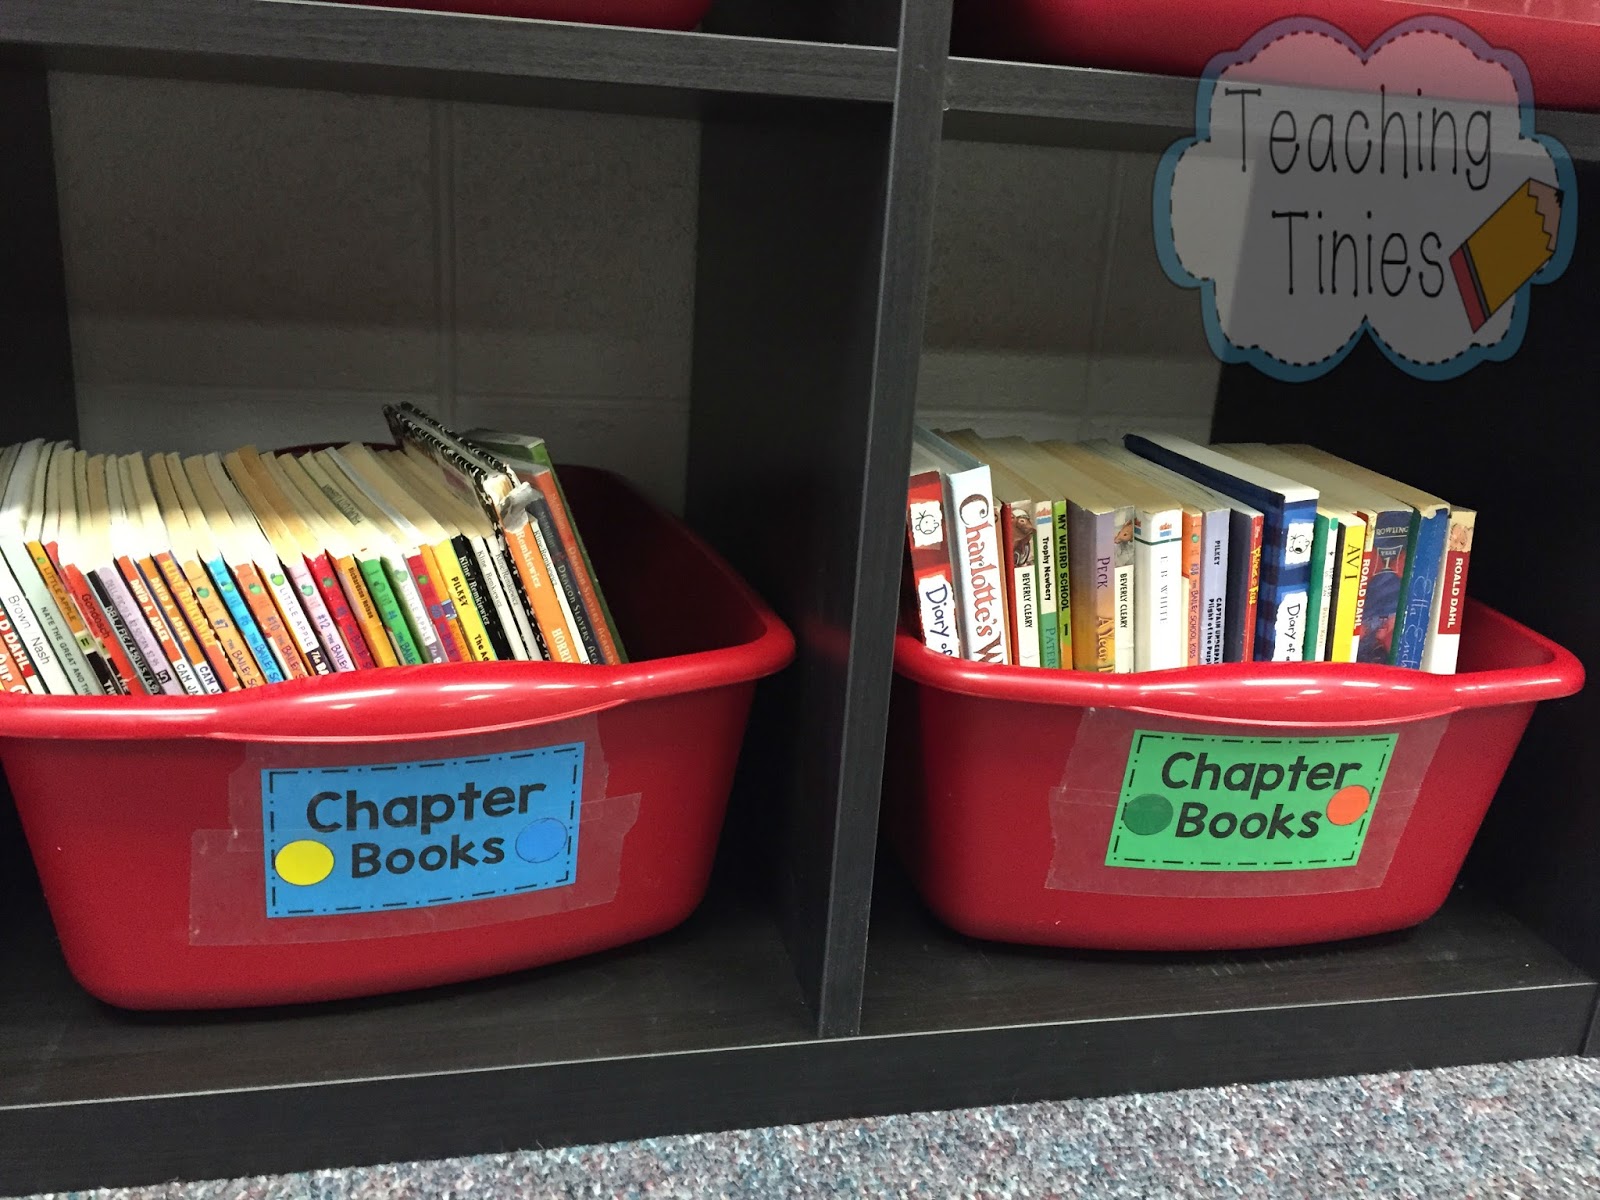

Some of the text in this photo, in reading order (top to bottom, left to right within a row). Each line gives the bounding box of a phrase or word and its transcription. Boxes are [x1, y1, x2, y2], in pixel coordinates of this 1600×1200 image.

[1213, 540, 1221, 565] PILKEY
[1376, 527, 1409, 536] ROWLING
[478, 551, 488, 568] Kline
[516, 532, 542, 588] Remkiewicz
[959, 493, 998, 638] Charlotte's
[1042, 537, 1052, 602] Trophy Newbery
[1058, 514, 1069, 611] MY WEIRD SCHOOL
[1097, 557, 1110, 589] PECK
[1345, 544, 1361, 580] AVI
[1384, 557, 1391, 570] 1
[44, 567, 76, 621] LITTLE APPLE
[130, 579, 148, 603] DAVID
[151, 615, 170, 641] ADLER
[150, 577, 169, 602] DAVID
[172, 616, 191, 642] ADLER
[401, 585, 419, 611] LITTLE
[414, 616, 432, 641] APPLE
[451, 577, 468, 607] PILKEY
[460, 556, 472, 577] Kline
[470, 582, 490, 625] Remkiewicz
[926, 584, 950, 638] Diary
[1022, 573, 1033, 629] BEVERLY CLEARY
[1120, 573, 1128, 629] BEVERLY CLEARY
[1207, 599, 1216, 621] Plight
[1214, 597, 1223, 628] CAPTAIN
[1353, 558, 1370, 629] ROALD DAHL
[1447, 558, 1463, 628] ROALD DAHL
[9, 594, 33, 629] Brown
[31, 637, 51, 665] Nash
[81, 593, 110, 639] Gondosch
[280, 588, 313, 647] LITTLE APPLE
[1284, 604, 1300, 640] Diary
[4, 632, 29, 671] DAHL
[41, 607, 55, 626] NATE
[52, 627, 63, 641] THE
[59, 642, 76, 666] GREAT
[73, 668, 85, 682] AND
[215, 618, 228, 631] #7
[232, 650, 254, 678] BAILEY
[254, 644, 277, 672] BAILEY
[281, 645, 303, 673] BAILEY
[311, 650, 323, 663] The
[316, 614, 351, 671] #12 THE BAILEY
[474, 635, 485, 650] The
[1287, 643, 1295, 654] of
[176, 664, 191, 682] CAM
[200, 666, 215, 685] CAM
[1161, 752, 1363, 800] Chapter
[307, 782, 547, 834] Chapter
[1175, 802, 1323, 840] Books
[351, 835, 505, 878] Books
